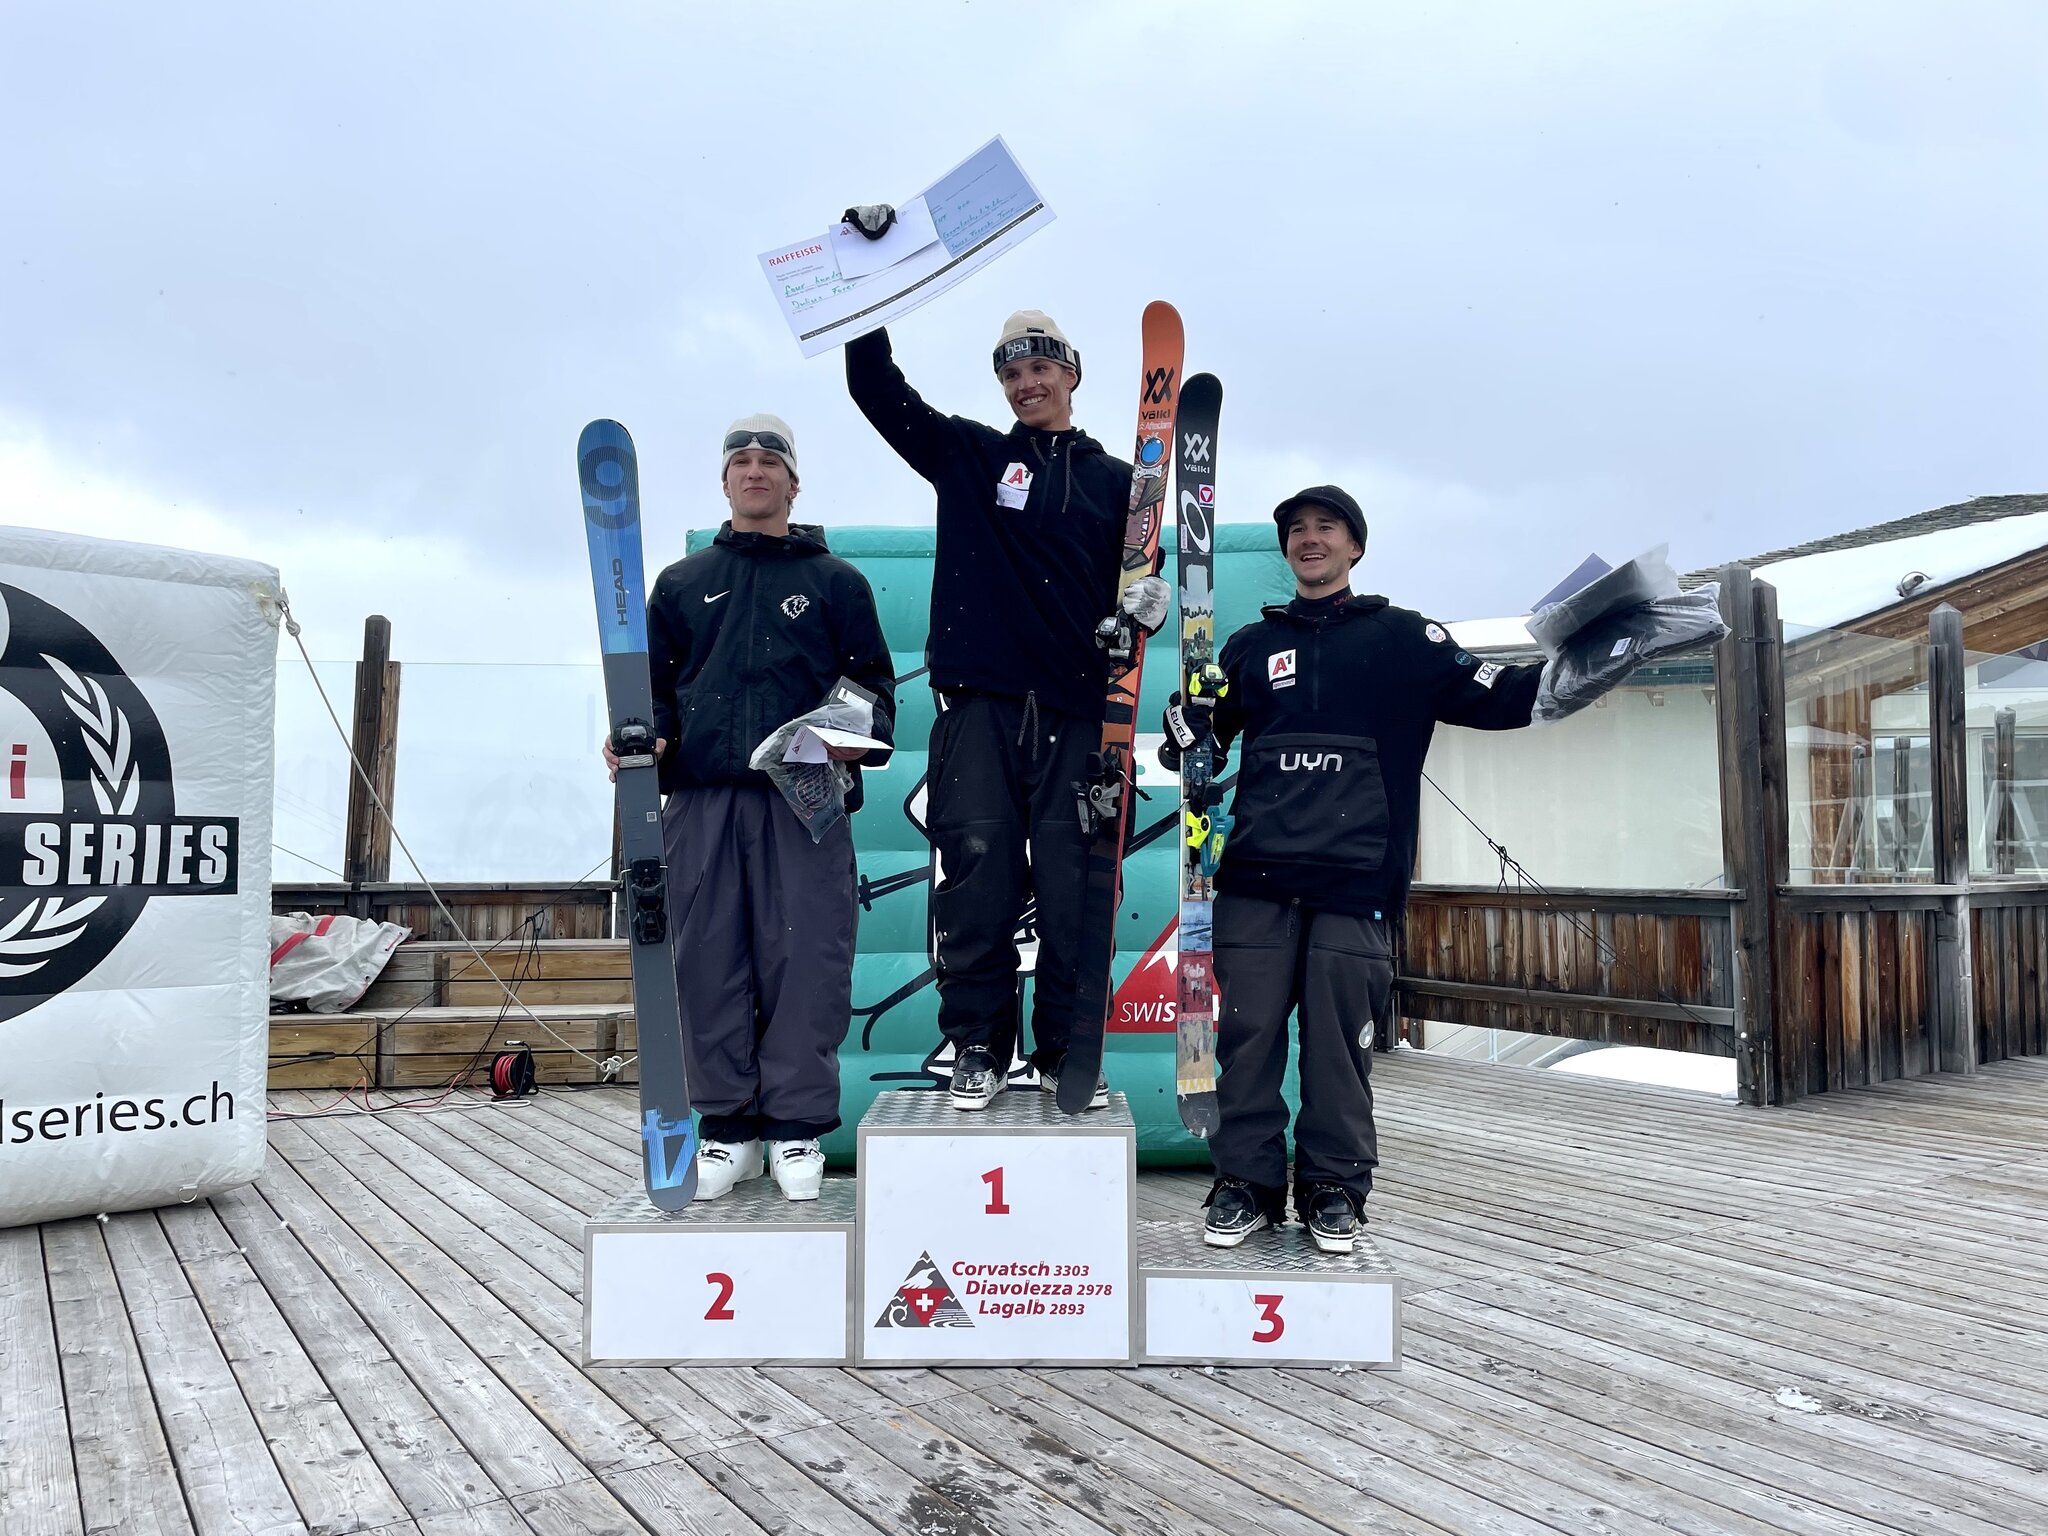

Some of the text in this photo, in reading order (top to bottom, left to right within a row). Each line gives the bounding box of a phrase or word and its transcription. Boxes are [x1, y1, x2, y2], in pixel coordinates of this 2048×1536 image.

[768, 244, 823, 267] RAIFFEISEN
[1141, 409, 1171, 421] Völkl
[1183, 463, 1211, 474] Völkl
[611, 557, 629, 626] HEAD
[1271, 652, 1292, 676] A1
[1169, 706, 1187, 742] LEVEL
[22, 822, 229, 887] SERIES
[1119, 993, 1178, 1024] swis
[0, 1080, 235, 1145] series.ch
[980, 1166, 1010, 1215] 1
[952, 1260, 1090, 1277] Corvatsch 3303
[703, 1272, 736, 1321] 2
[965, 1279, 1113, 1296] Diavolezza 2978
[978, 1298, 1085, 1319] Lagalb 2893
[1251, 1293, 1285, 1343] 3
